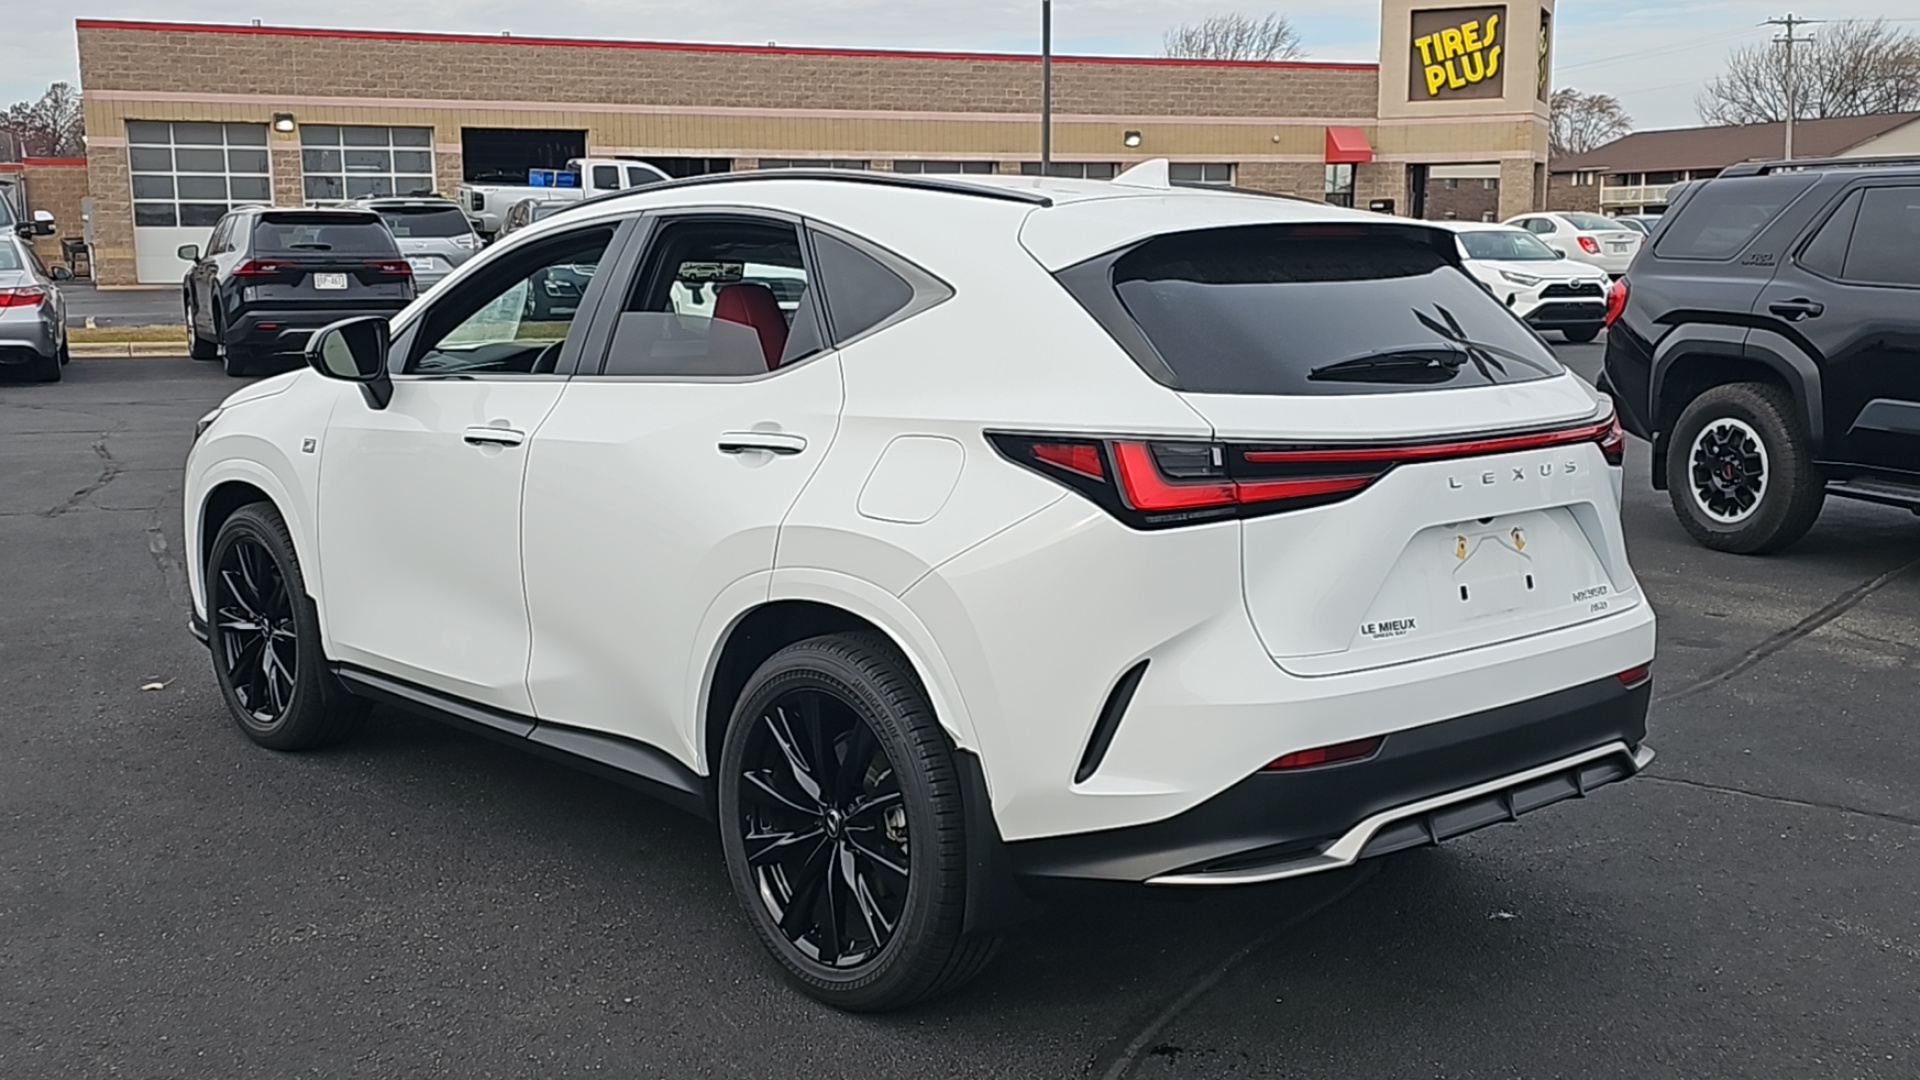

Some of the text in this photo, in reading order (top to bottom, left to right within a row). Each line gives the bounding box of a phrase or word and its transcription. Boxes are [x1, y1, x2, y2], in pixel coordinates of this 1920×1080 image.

[1414, 14, 1499, 66] TIRES
[1424, 45, 1501, 95] PLUS
[1448, 461, 1576, 489] LEXUS
[1361, 618, 1416, 635] LE MIEUX
